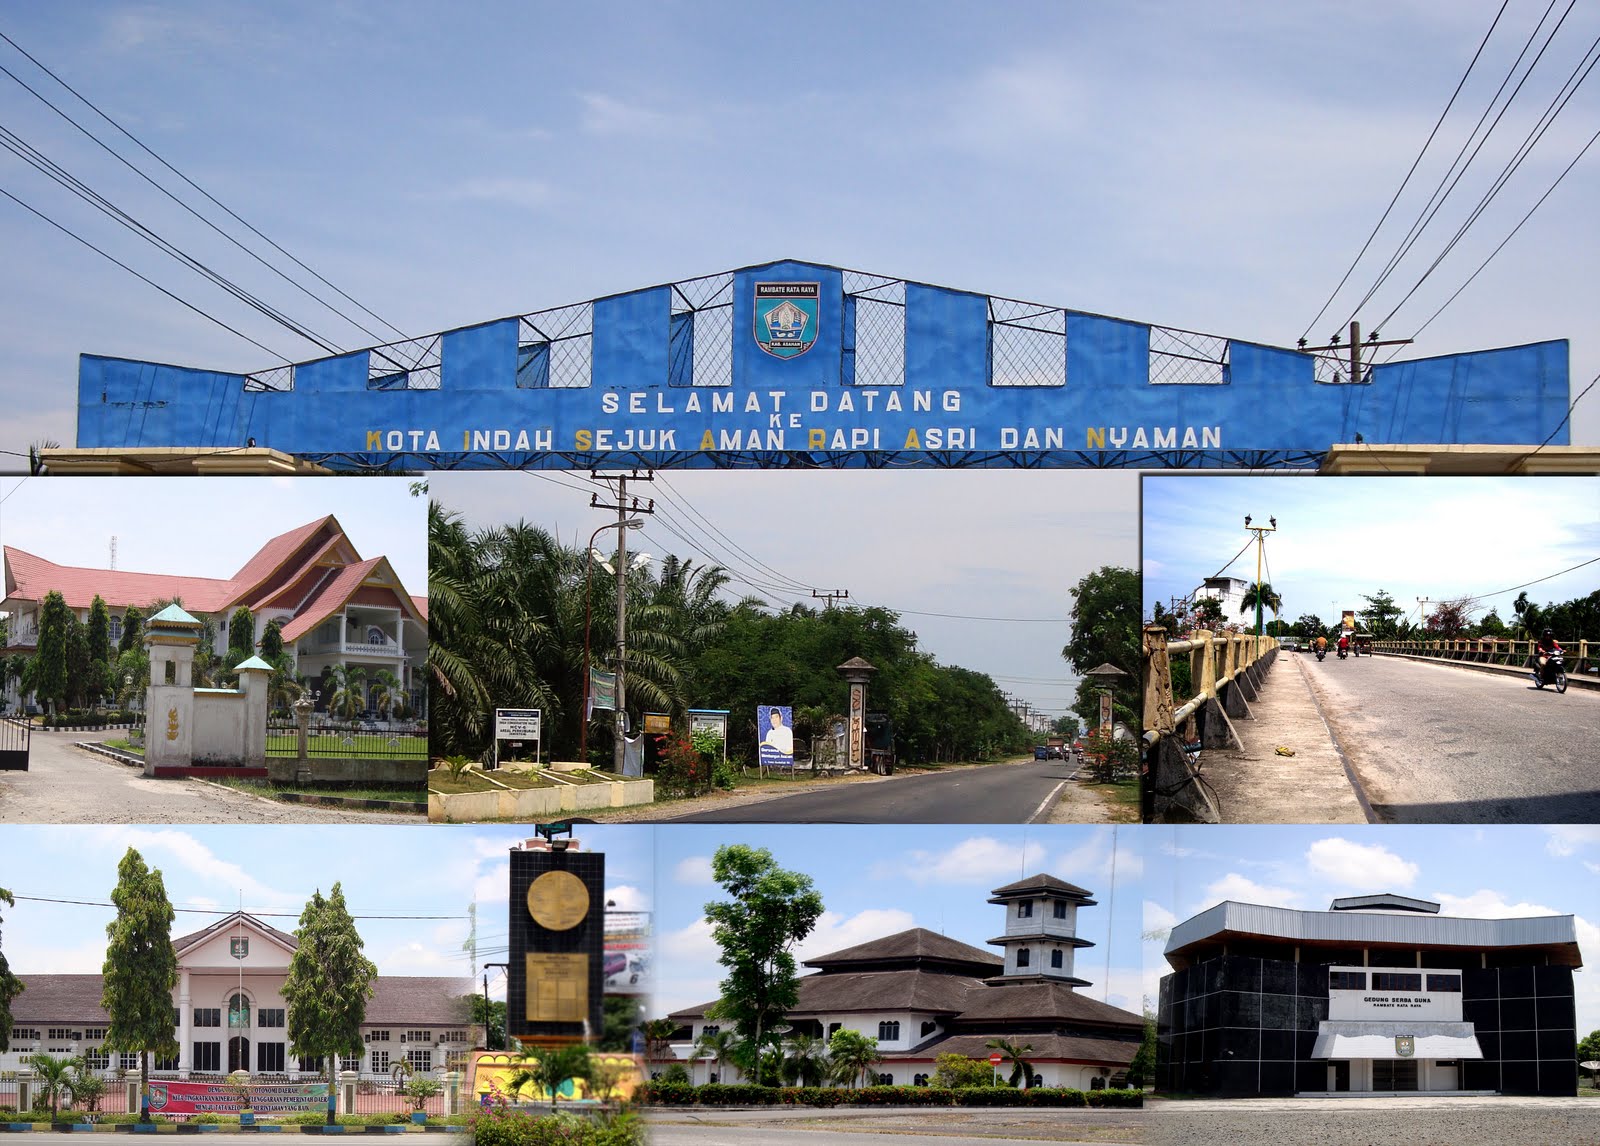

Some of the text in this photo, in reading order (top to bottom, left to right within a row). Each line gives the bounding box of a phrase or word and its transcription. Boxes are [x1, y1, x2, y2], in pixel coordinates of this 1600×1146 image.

[602, 390, 962, 414] SELAMAT DATANG
[769, 413, 802, 429] KE
[366, 426, 1221, 451] KOTA INDAH SEJUK AMAN RAPI ASRI DAN NYAMAN
